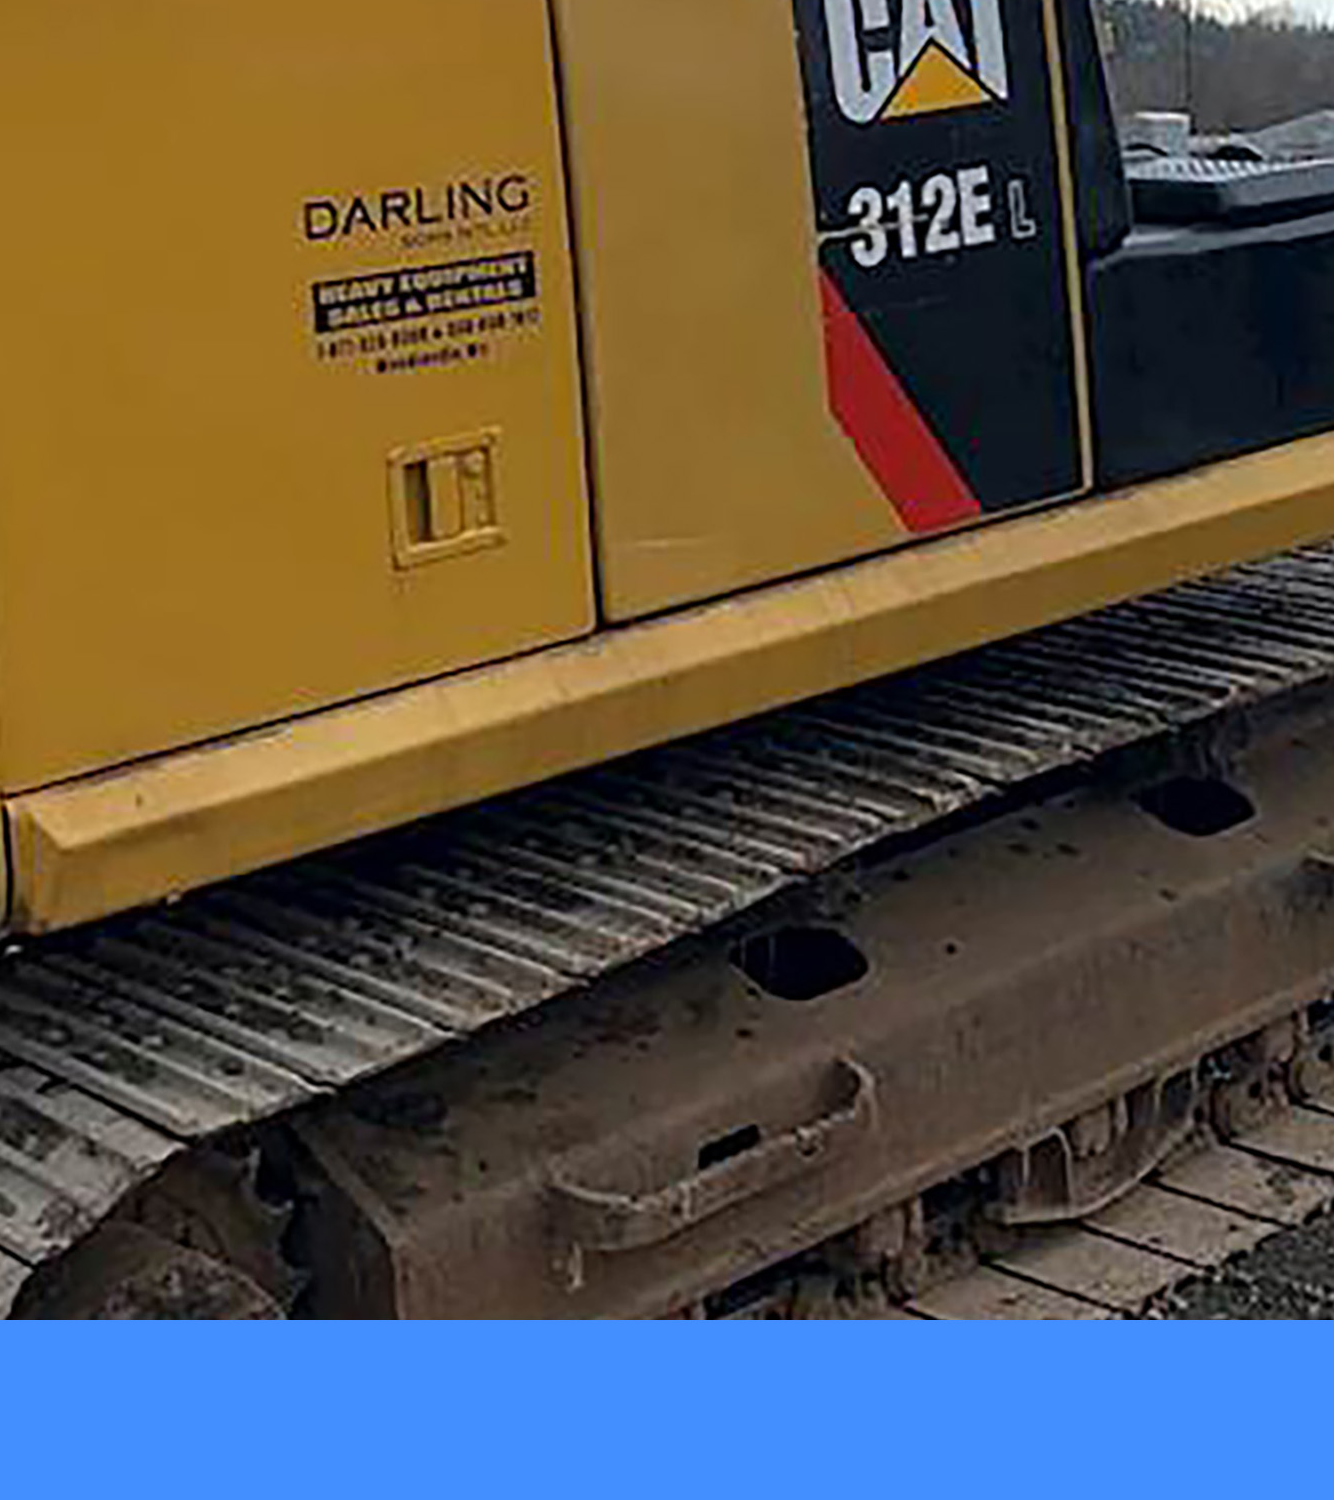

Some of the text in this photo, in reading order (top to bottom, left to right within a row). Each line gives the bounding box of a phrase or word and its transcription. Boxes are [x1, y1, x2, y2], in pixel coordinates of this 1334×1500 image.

[304, 174, 530, 240] DARLING
[847, 165, 1037, 268] 312E L
